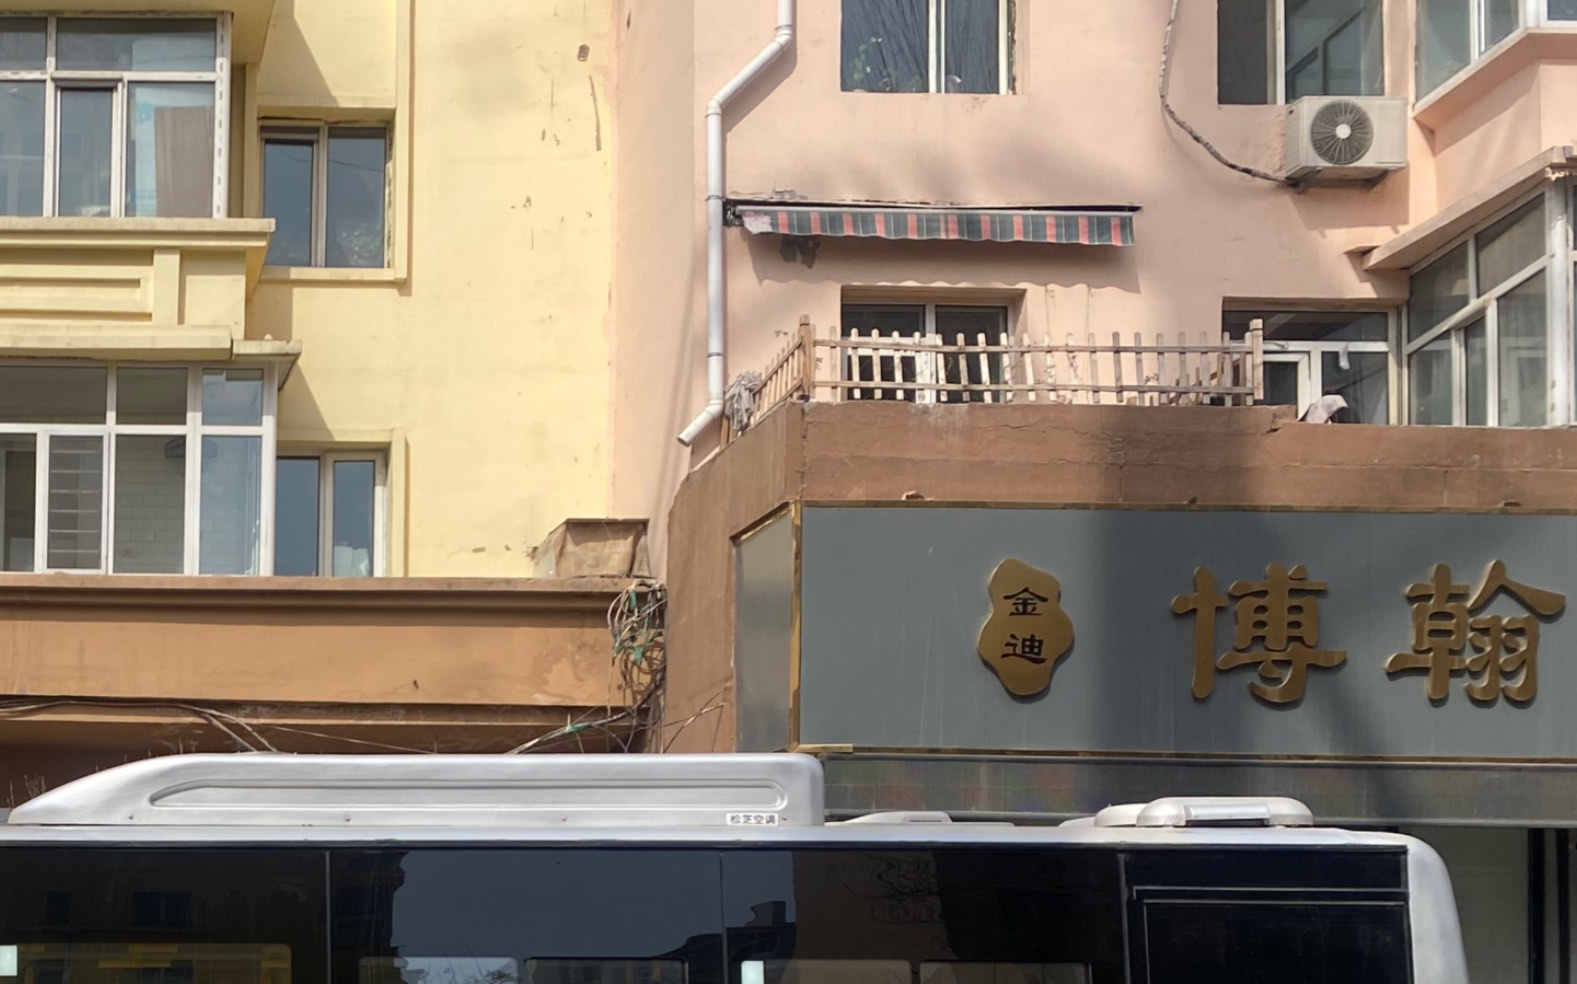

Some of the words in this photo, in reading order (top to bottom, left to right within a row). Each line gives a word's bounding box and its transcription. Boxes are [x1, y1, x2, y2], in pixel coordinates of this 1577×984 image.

[1001, 586, 1049, 665] 金迪
[1171, 559, 1567, 704] 博翰
[730, 814, 776, 825] 松芝空调
